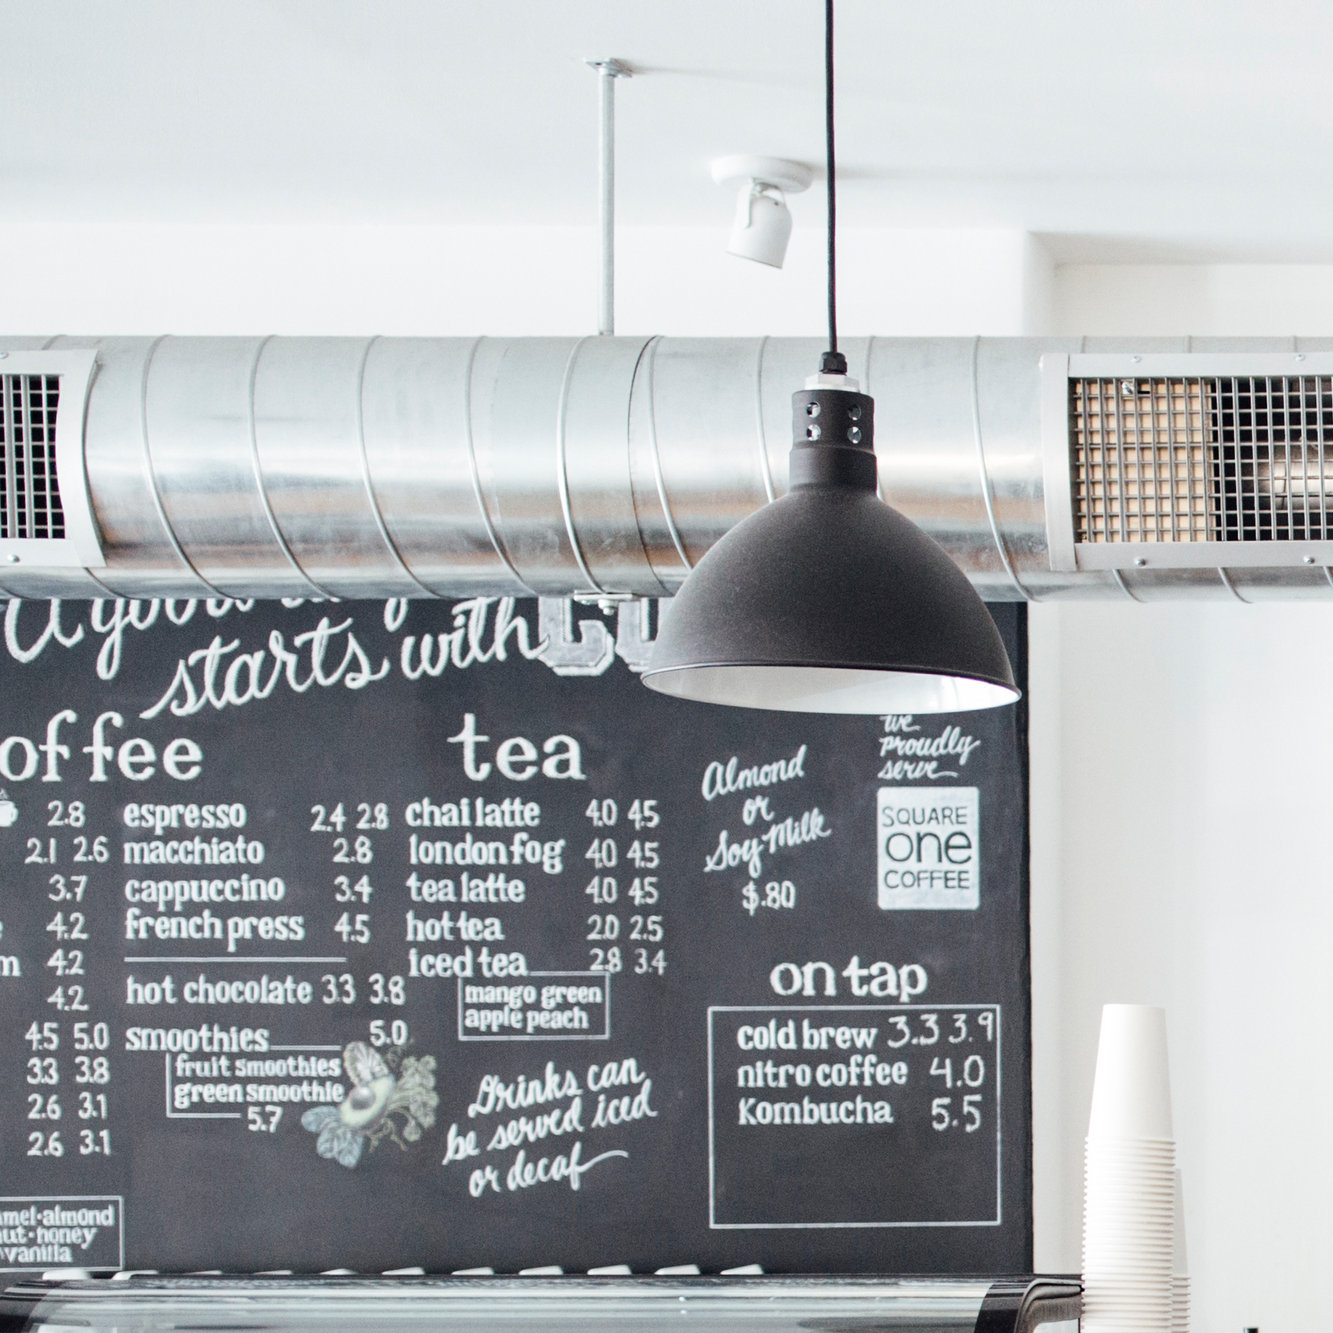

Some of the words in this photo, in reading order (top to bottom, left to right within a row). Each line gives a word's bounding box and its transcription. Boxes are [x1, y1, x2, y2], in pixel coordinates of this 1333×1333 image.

[139, 616, 391, 719] starts
[401, 597, 549, 680] with
[447, 713, 586, 782] tea
[876, 759, 960, 780] serve
[48, 801, 85, 827] 2.8
[123, 803, 247, 836] espresso
[310, 803, 347, 832] 2.4
[356, 803, 390, 830] 2.8
[405, 797, 472, 828] chai
[476, 797, 541, 828] latte
[585, 799, 619, 827] 4.0
[626, 799, 661, 830] 4.5
[742, 795, 775, 826] or
[881, 805, 968, 828] SQUARE
[25, 838, 56, 863] 2.1
[73, 836, 110, 863] 2.6
[123, 836, 265, 864] macchiato
[333, 836, 373, 864] 2.8
[408, 833, 508, 865] london
[511, 832, 566, 874] fog
[585, 838, 619, 870] 4.0
[626, 840, 661, 870] 4.5
[703, 829, 765, 879] Soy
[884, 830, 973, 865] one
[49, 874, 88, 902] 3.7
[124, 874, 286, 912] cappuccino
[334, 875, 373, 903] 3.4
[405, 872, 456, 902] tea
[460, 872, 527, 903] latte
[585, 876, 619, 905] 4.0
[627, 876, 660, 906] 4.5
[883, 869, 971, 890] COFFEE
[741, 880, 797, 917] $.80
[46, 911, 89, 940] 4.2
[125, 908, 223, 940] french
[227, 915, 306, 952] press
[334, 912, 371, 944] 4.5
[405, 910, 456, 942] hot
[456, 911, 506, 942] tea
[586, 914, 621, 941] 2.0
[629, 916, 664, 943] 2.5
[47, 949, 85, 976] 4.2
[408, 946, 473, 979] iced
[476, 949, 529, 978] tea
[588, 948, 623, 974] 2.8
[633, 949, 668, 977] 3.4
[126, 975, 178, 1005] hot
[184, 974, 314, 1004] chocolate
[321, 974, 357, 1004] 3.3
[369, 973, 406, 1005] 3.8
[769, 961, 837, 997] on
[841, 954, 929, 1003] tap
[48, 985, 89, 1011] 4.2
[464, 985, 537, 1010] mango
[540, 985, 603, 1010] green
[25, 1021, 59, 1050] 4.5
[73, 1023, 110, 1050] 5.0
[125, 1026, 270, 1051] smoothies
[369, 1020, 408, 1046] 5.0
[464, 1007, 524, 1033] apple
[526, 1006, 590, 1034] peach
[736, 1017, 798, 1051] cold
[801, 1017, 879, 1050] brew
[886, 1012, 941, 1049] 3.3
[947, 1010, 995, 1045] 3.9
[27, 1057, 59, 1084] 3.3
[75, 1056, 110, 1084] 3.8
[176, 1054, 231, 1077] fruit
[235, 1056, 342, 1077] smoothies
[736, 1058, 812, 1089] nitro
[815, 1053, 909, 1087] coffee
[928, 1053, 986, 1090] 4.0
[174, 1083, 243, 1109] green
[246, 1081, 346, 1102] smoothie
[467, 1061, 584, 1118] Drinks
[586, 1057, 646, 1093] can
[27, 1094, 61, 1119] 2.6
[78, 1091, 107, 1119] 3.1
[247, 1106, 283, 1133] 5.7
[737, 1093, 895, 1126] Kombucha
[929, 1093, 983, 1133] 5.5
[441, 1123, 480, 1166] be
[486, 1095, 585, 1152] served
[591, 1078, 659, 1129] iced
[27, 1131, 64, 1156] 2.6
[79, 1129, 111, 1155] 3.1
[468, 1165, 502, 1199] or
[506, 1141, 630, 1192] decaf
